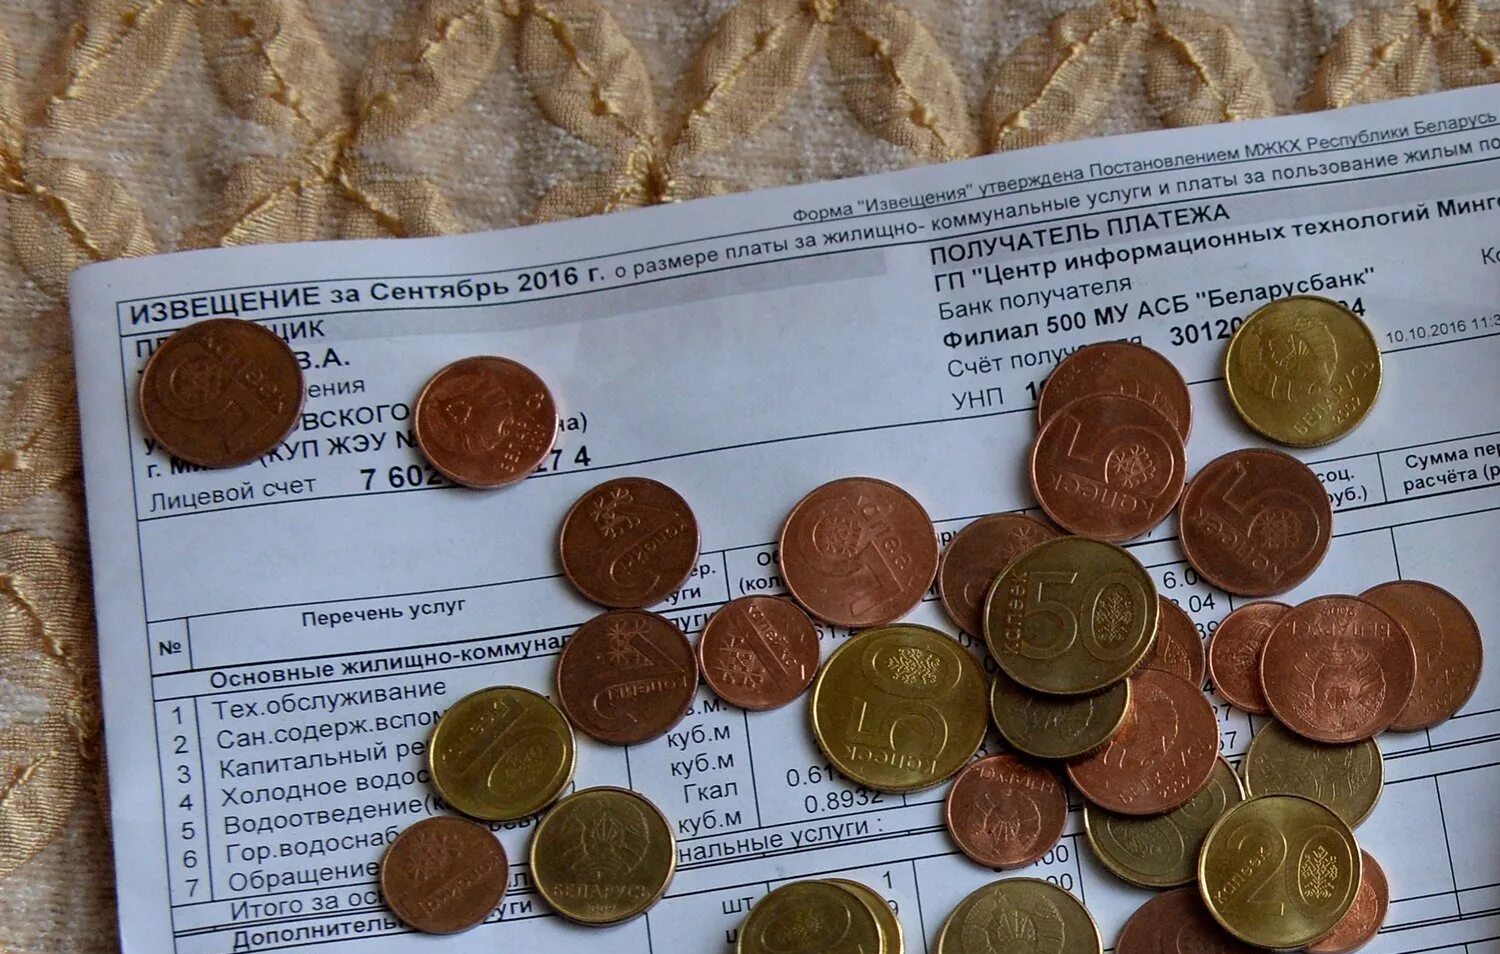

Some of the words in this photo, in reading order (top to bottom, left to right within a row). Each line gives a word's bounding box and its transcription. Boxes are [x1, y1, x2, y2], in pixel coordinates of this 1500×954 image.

[793, 203, 853, 224] Форма
[858, 184, 972, 214] "Извещения"
[979, 167, 1084, 198] утверждена
[1090, 148, 1239, 180] Постановлением
[1245, 139, 1300, 158] МЖКХ
[1308, 127, 1409, 150] Республики
[1414, 111, 1495, 137] Беларусь
[130, 287, 320, 324] ИЗВЕЩЕНИЕ
[370, 280, 508, 302] Сентябрь
[519, 267, 578, 292] 2016
[633, 249, 718, 279] размере
[726, 238, 787, 260] платы
[932, 194, 1080, 232] коммунальные
[1088, 183, 1151, 208] услуги
[1177, 172, 1238, 196] платы
[1272, 155, 1398, 181] пользование
[1405, 142, 1473, 166] жилым
[931, 221, 1100, 265] ПОЛУЧАТЕЛЬ
[1108, 203, 1230, 237] ПЛАТЕЖА
[935, 269, 964, 292] ГП
[973, 261, 1056, 287] "Центр
[1065, 224, 1285, 269] информационных
[1292, 202, 1429, 238] технологий
[938, 299, 993, 321] Банк
[1000, 276, 1132, 312] получателя
[943, 322, 1039, 350] Филиал
[1047, 313, 1085, 333] 500
[1138, 295, 1188, 318] АСБ
[1387, 319, 1466, 344] 10.10.2016
[948, 356, 1003, 378] Счёт
[952, 388, 1003, 410] УНП
[328, 433, 393, 456] ЖЭУ
[1405, 448, 1467, 469] Сумма
[150, 482, 254, 512] Лицевой
[266, 477, 316, 497] счет
[1403, 469, 1477, 494] расчёта
[303, 605, 402, 628] Перечень
[409, 597, 467, 621] услуг
[210, 660, 334, 689] Основные
[213, 679, 446, 721] Тех.обслуживание
[666, 724, 730, 748] куб.м
[220, 741, 387, 779] Капитальный
[670, 753, 734, 777] куб.м
[222, 775, 347, 807] Холодное
[685, 781, 738, 802] Гкал
[795, 818, 870, 845] услуги
[229, 860, 379, 892] Обращение
[231, 896, 304, 921] Итого
